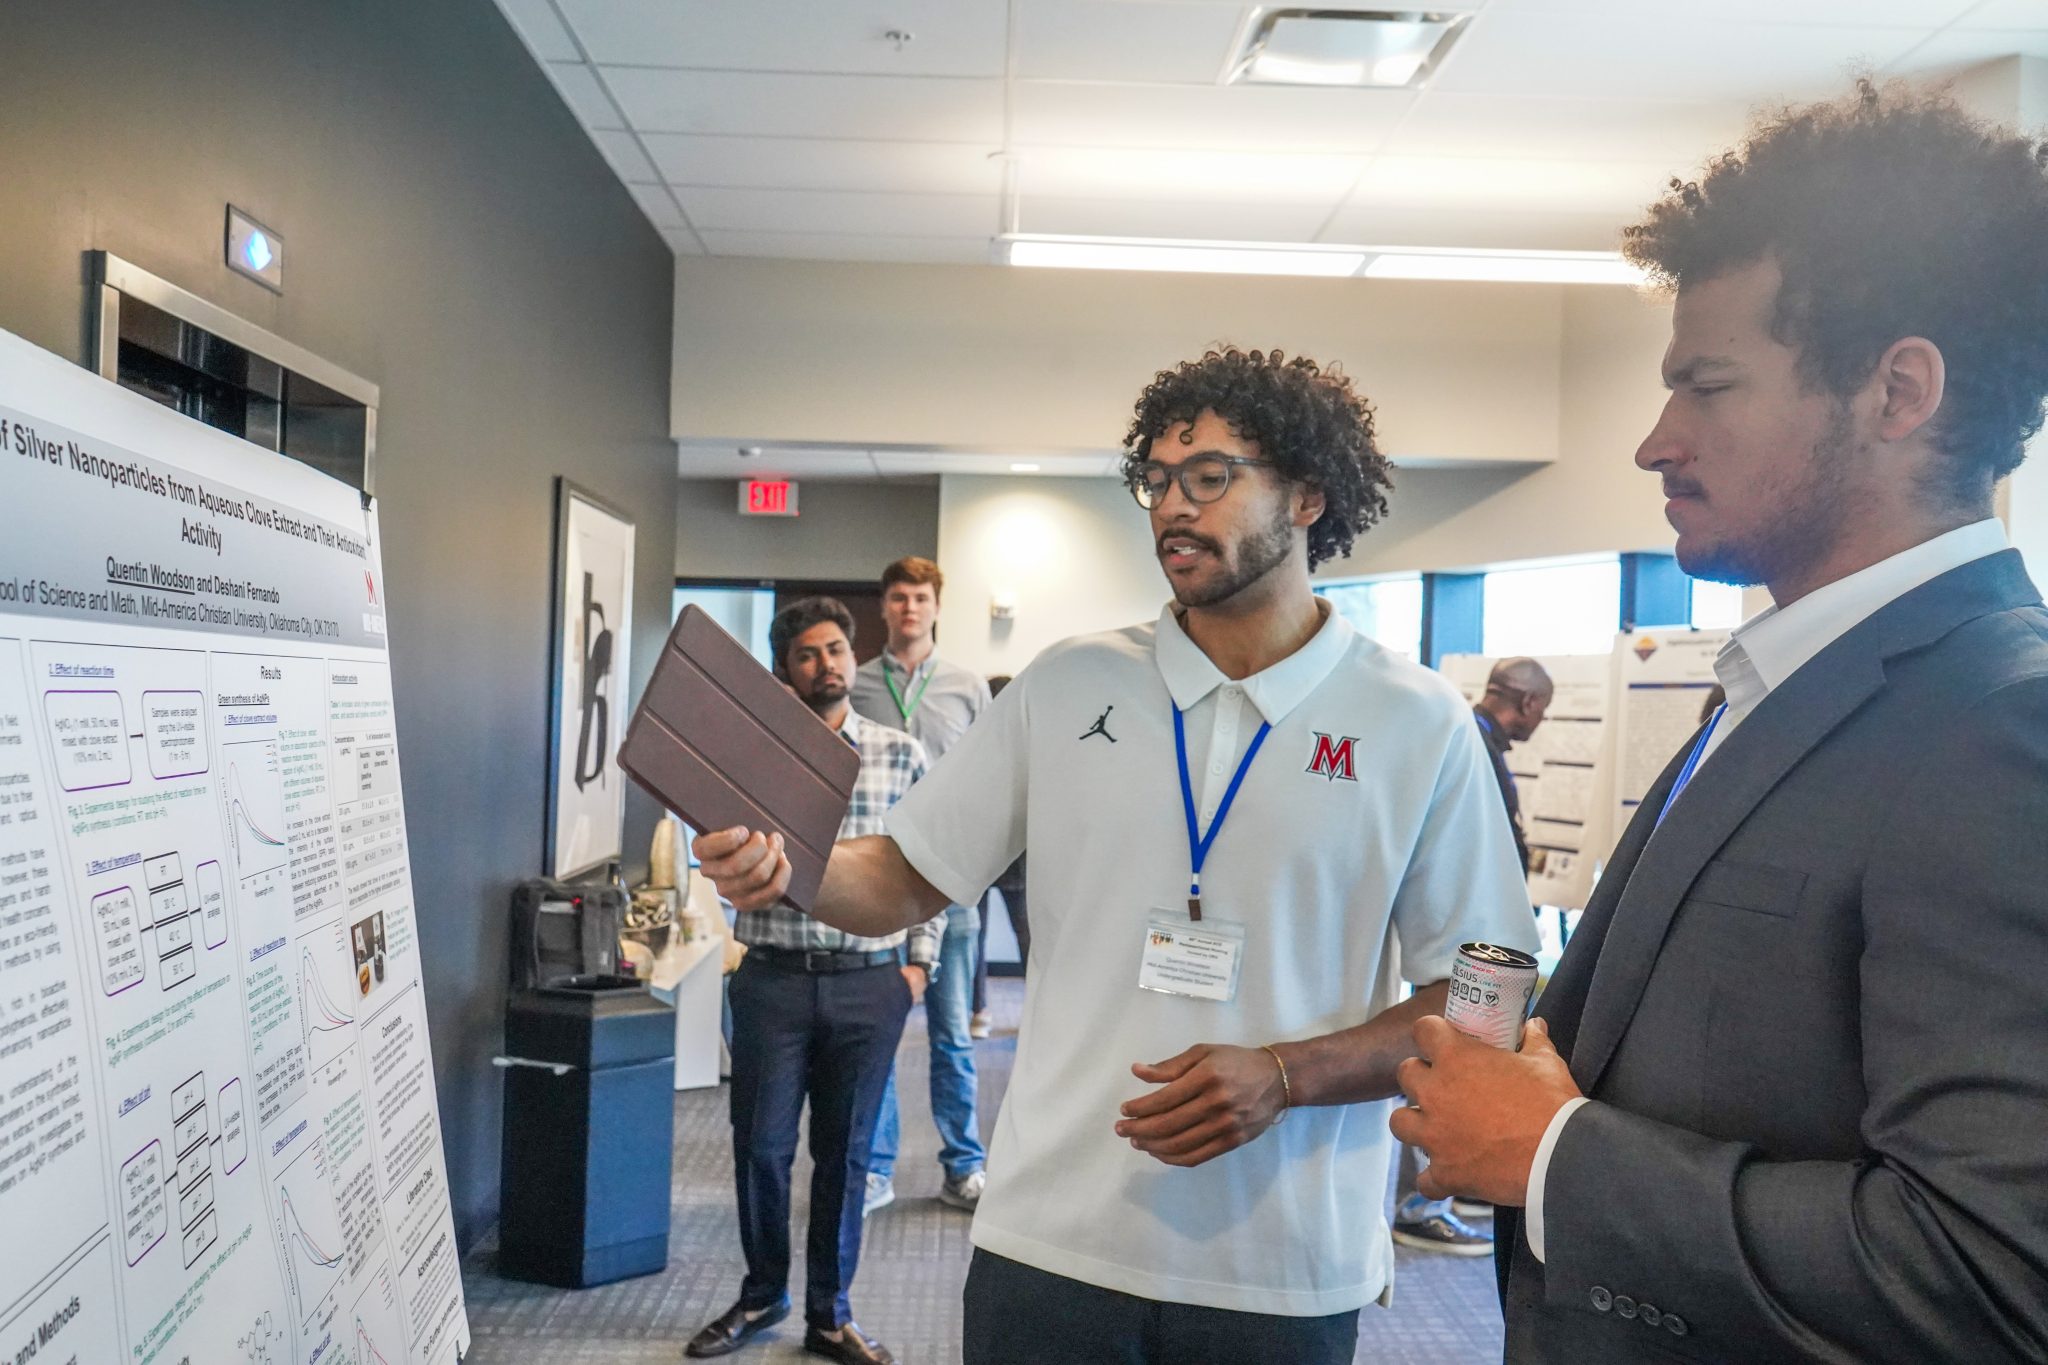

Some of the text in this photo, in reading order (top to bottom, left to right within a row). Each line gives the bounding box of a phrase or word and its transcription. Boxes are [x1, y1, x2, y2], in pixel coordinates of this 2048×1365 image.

[0, 418, 8, 451] f
[13, 423, 63, 466] Silver
[67, 440, 166, 497] Nanoparticles
[167, 474, 197, 506] from
[198, 485, 244, 520] Aqueous
[245, 500, 272, 529] Clove
[272, 509, 302, 539] Extract
[302, 523, 318, 543] and
[317, 525, 335, 549] Their
[748, 480, 789, 513] EXIT
[181, 517, 221, 556] Activity
[106, 555, 280, 604] Quentin Woodson and Deshani Fernando
[23, 579, 36, 603] of
[39, 580, 87, 610] Science
[89, 589, 108, 612] and
[111, 590, 139, 618] Math,
[141, 594, 196, 621] Mid-America
[198, 602, 232, 625] Christian
[233, 607, 268, 634] University,
[269, 612, 300, 633] Oklahoma
[300, 616, 314, 638] City,
[314, 618, 324, 636] OK
[260, 665, 282, 680] Results
[1304, 730, 1362, 782] M
[38, 1295, 81, 1350] Methods
